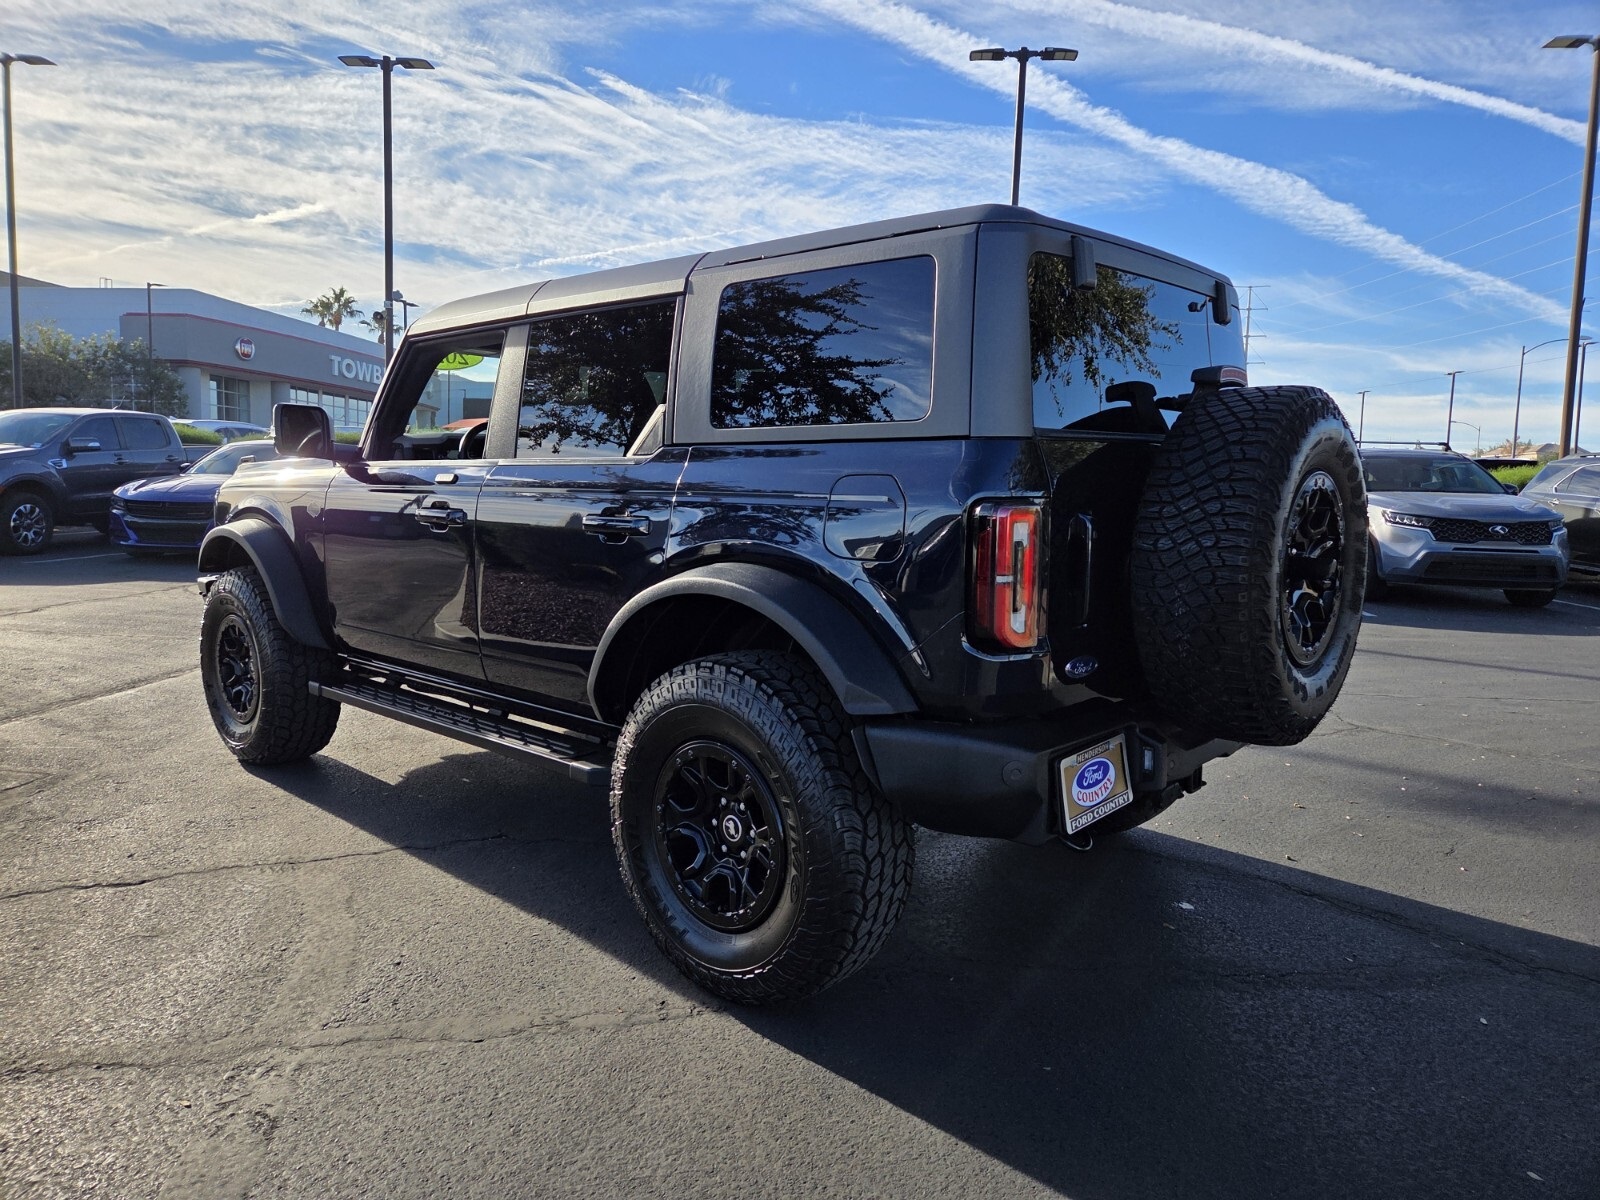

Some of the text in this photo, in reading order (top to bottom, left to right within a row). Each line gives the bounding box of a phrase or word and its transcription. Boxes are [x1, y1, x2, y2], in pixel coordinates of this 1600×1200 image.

[329, 355, 386, 385] TOWB
[1077, 743, 1110, 763] HENDERSON
[1083, 764, 1104, 787] Ford
[1077, 776, 1113, 803] COUNTRY
[1071, 793, 1129, 830] FORD COUNTRY
